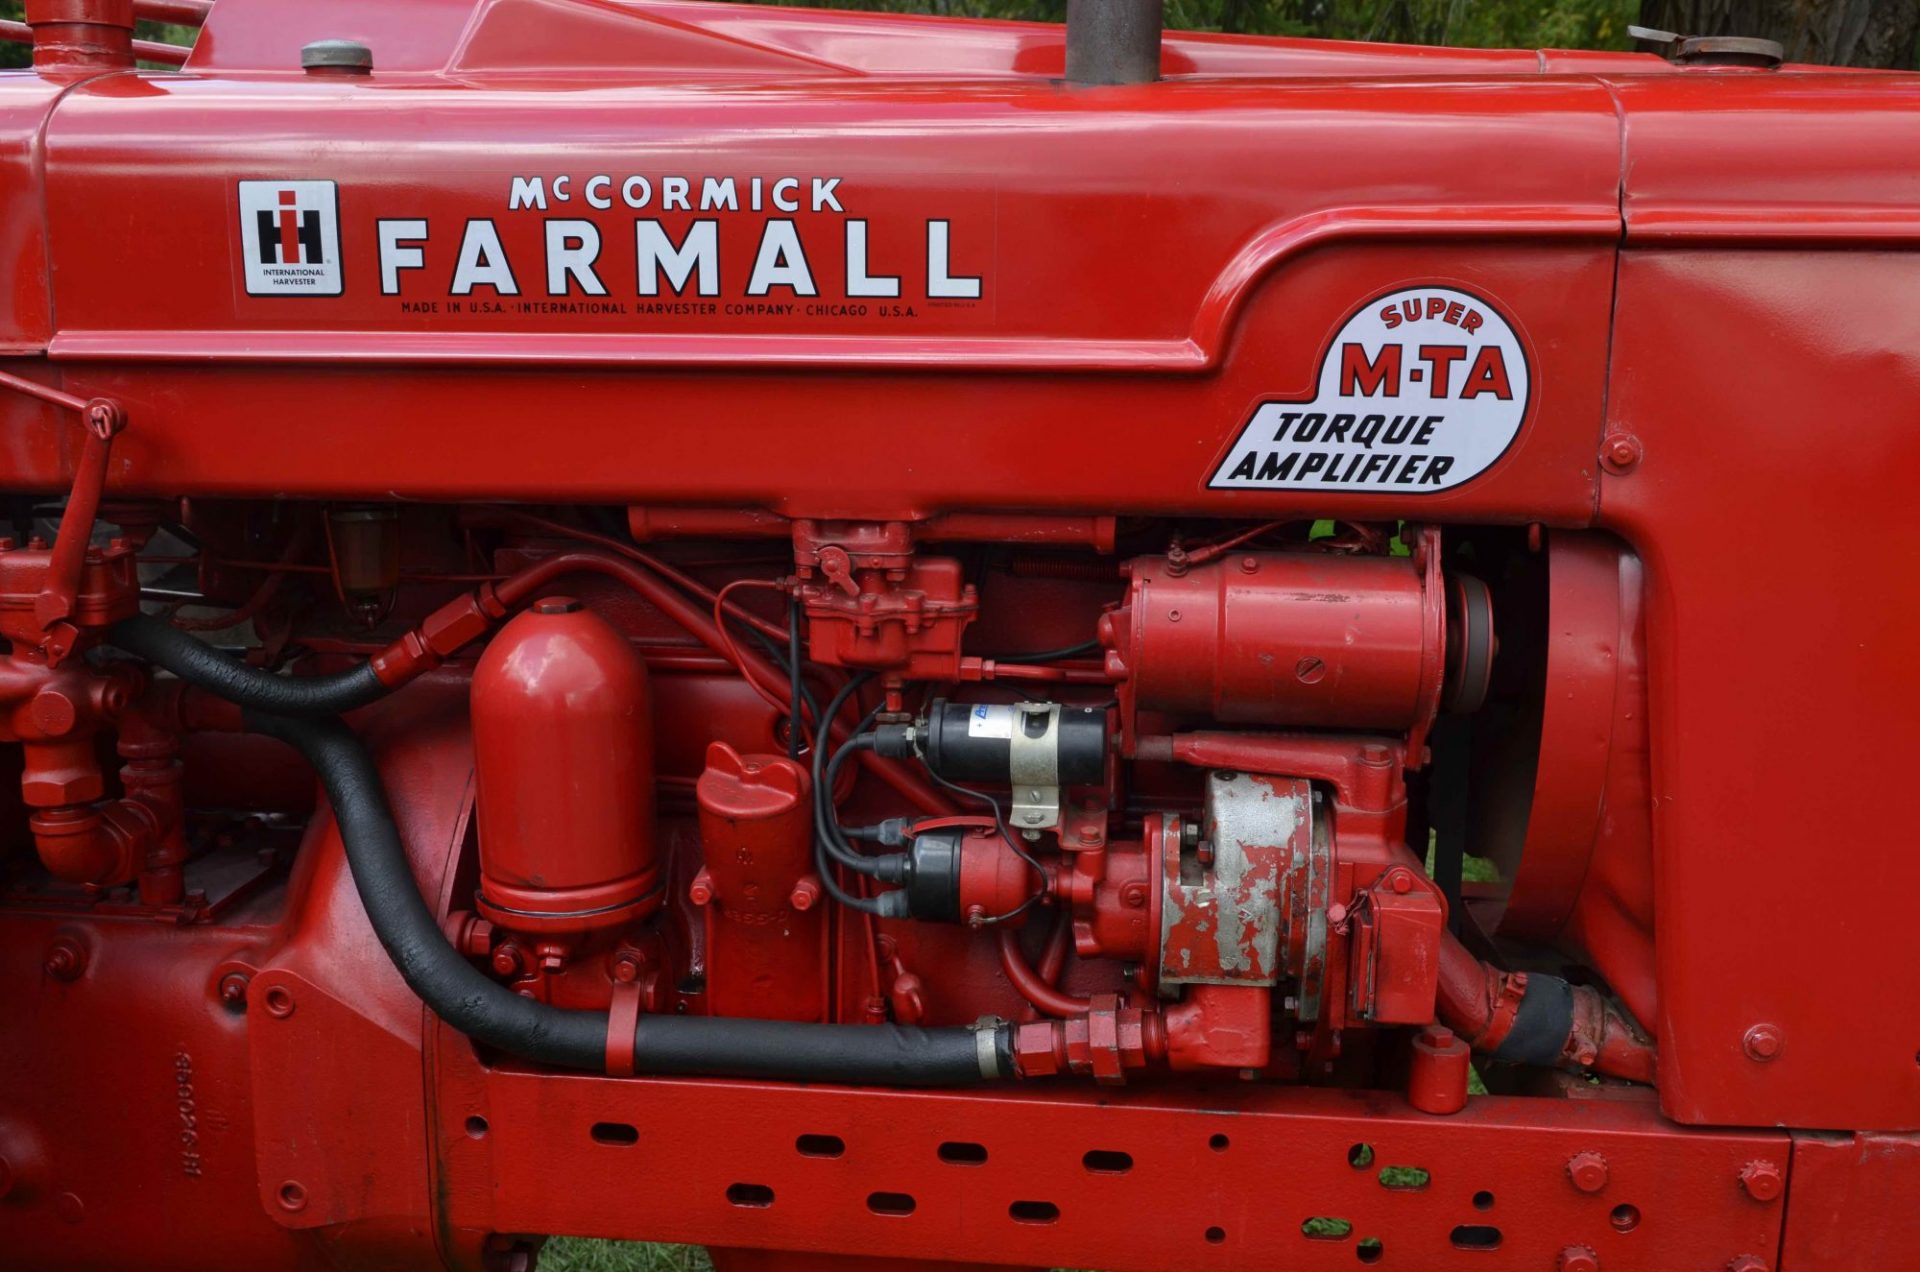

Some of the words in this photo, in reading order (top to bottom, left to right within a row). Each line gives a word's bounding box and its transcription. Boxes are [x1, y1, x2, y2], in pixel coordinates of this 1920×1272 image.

[263, 268, 325, 277] INTERNATIONAL
[377, 217, 983, 299] FARMALL
[273, 278, 316, 286] HARVESTER
[401, 302, 438, 313] MADE
[447, 302, 461, 313] IN
[470, 302, 506, 313] U.S.A.
[517, 302, 627, 314] INTERNATIONAL
[636, 303, 717, 315] HARVESTER
[724, 303, 794, 315] COMPANY
[806, 304, 868, 316] CHICAGO
[879, 304, 918, 317] U.S.A.
[1379, 297, 1484, 335] SUPER
[1272, 412, 1445, 449] TORQUE
[1227, 451, 1455, 485] AMPLIFIER
